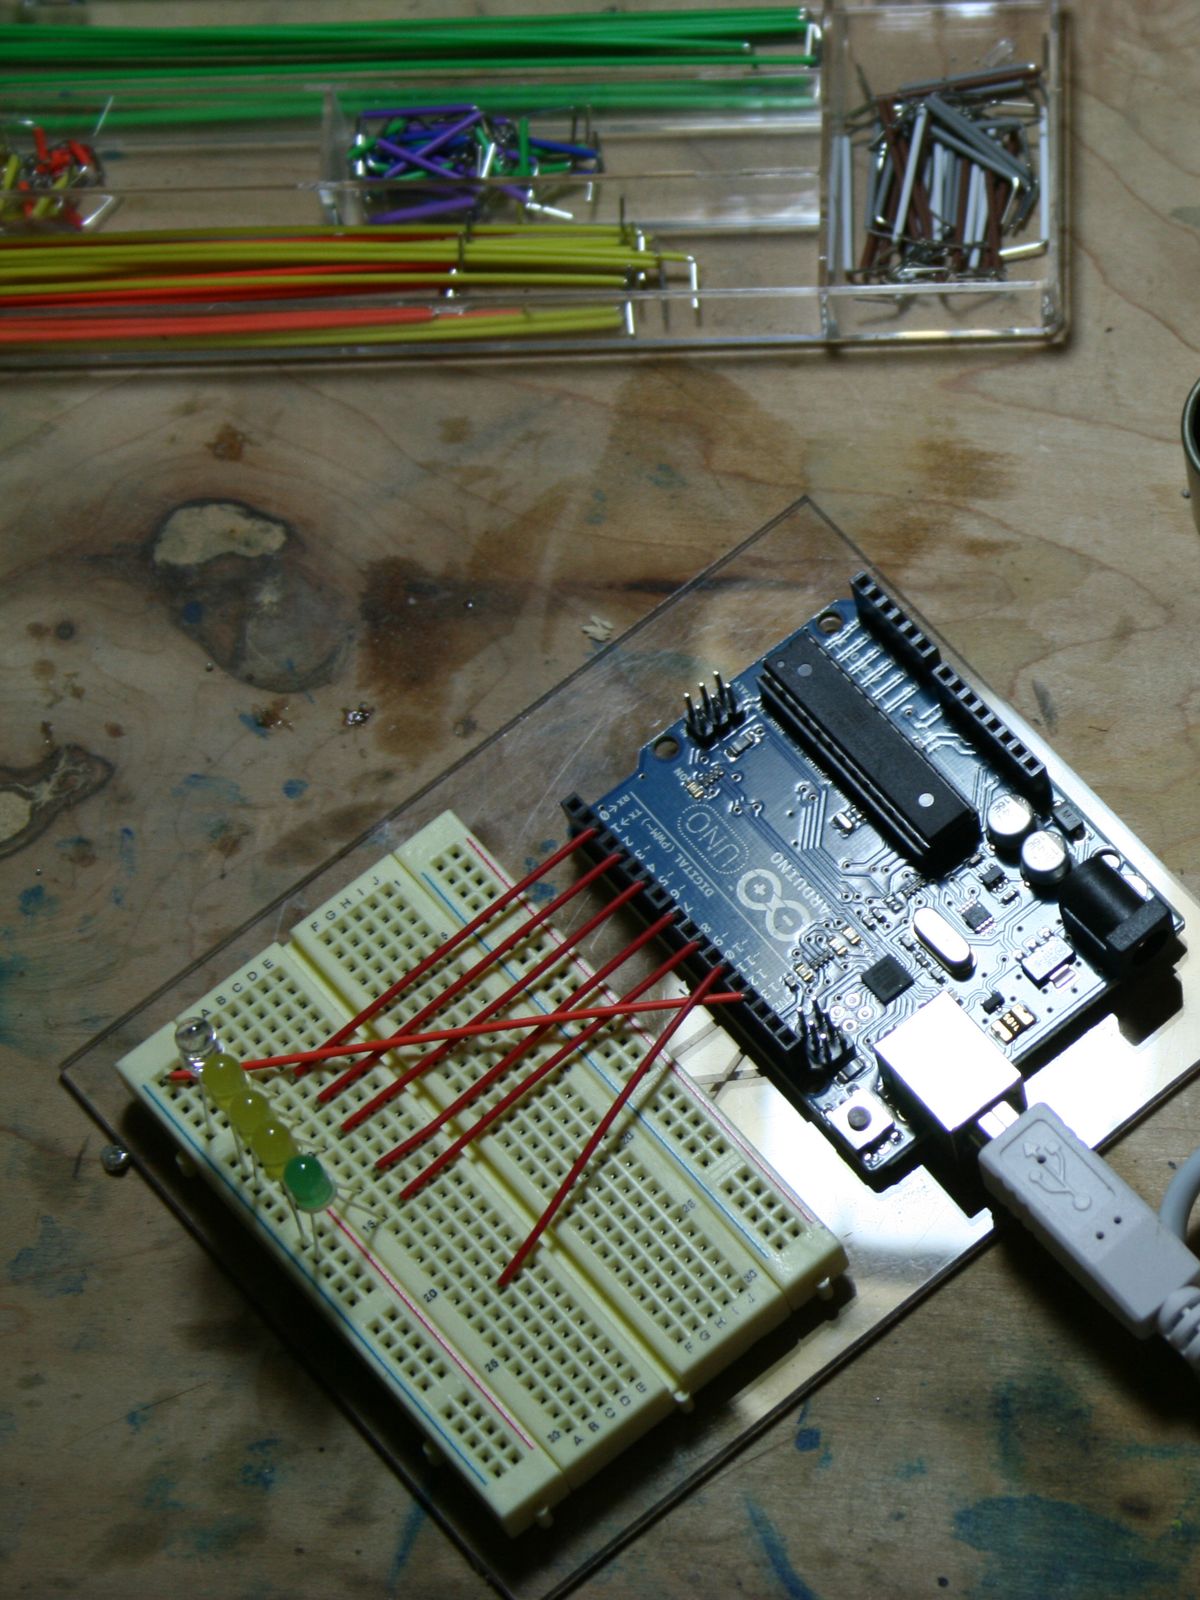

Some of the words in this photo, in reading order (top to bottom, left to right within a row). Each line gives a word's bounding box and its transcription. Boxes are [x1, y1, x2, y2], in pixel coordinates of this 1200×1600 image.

[640, 816, 677, 853] (PWM~)
[686, 811, 742, 865] UNO
[674, 853, 714, 898] DIGITAL
[770, 851, 831, 915] ARDUINO
